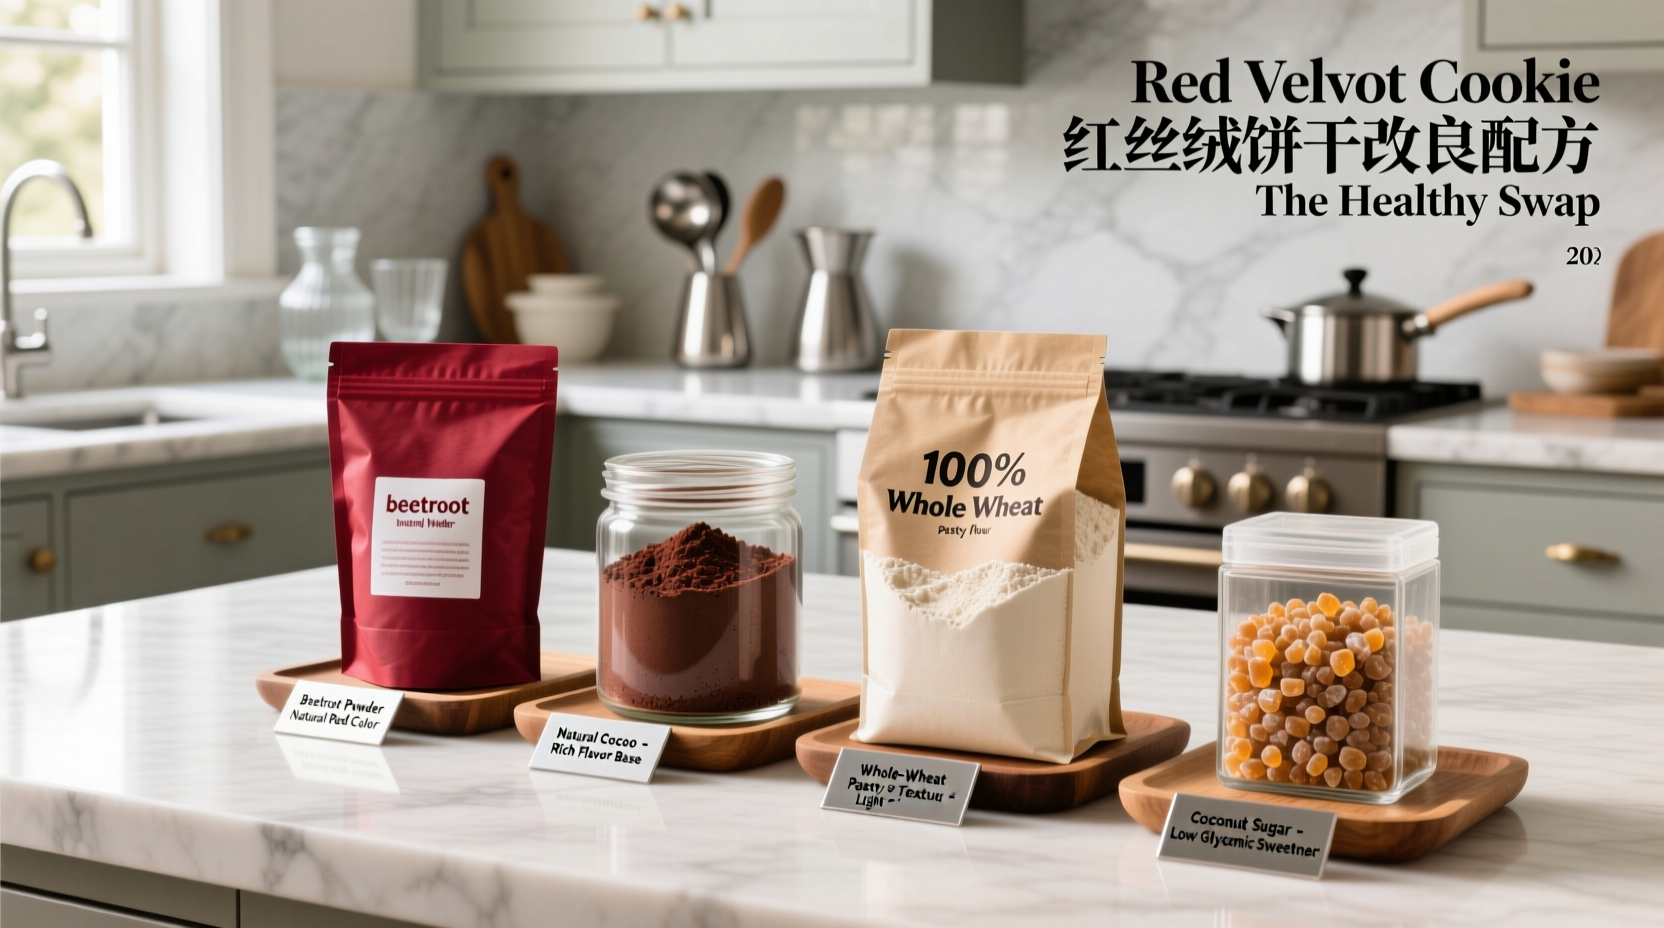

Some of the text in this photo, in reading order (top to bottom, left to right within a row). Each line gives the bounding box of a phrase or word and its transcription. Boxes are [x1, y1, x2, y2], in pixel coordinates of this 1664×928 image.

[923, 450, 1026, 488] 100%
[386, 494, 470, 515] beetroot
[887, 488, 1044, 518] Whole Wheat
[290, 709, 328, 723] Natural
[350, 716, 381, 730] Color
[556, 726, 599, 743] Natural
[550, 742, 576, 756] Rich
[614, 751, 642, 765] Base
[1252, 818, 1292, 838] Sugar
[1170, 826, 1198, 842] Low
[1256, 838, 1321, 858] Sweetner
